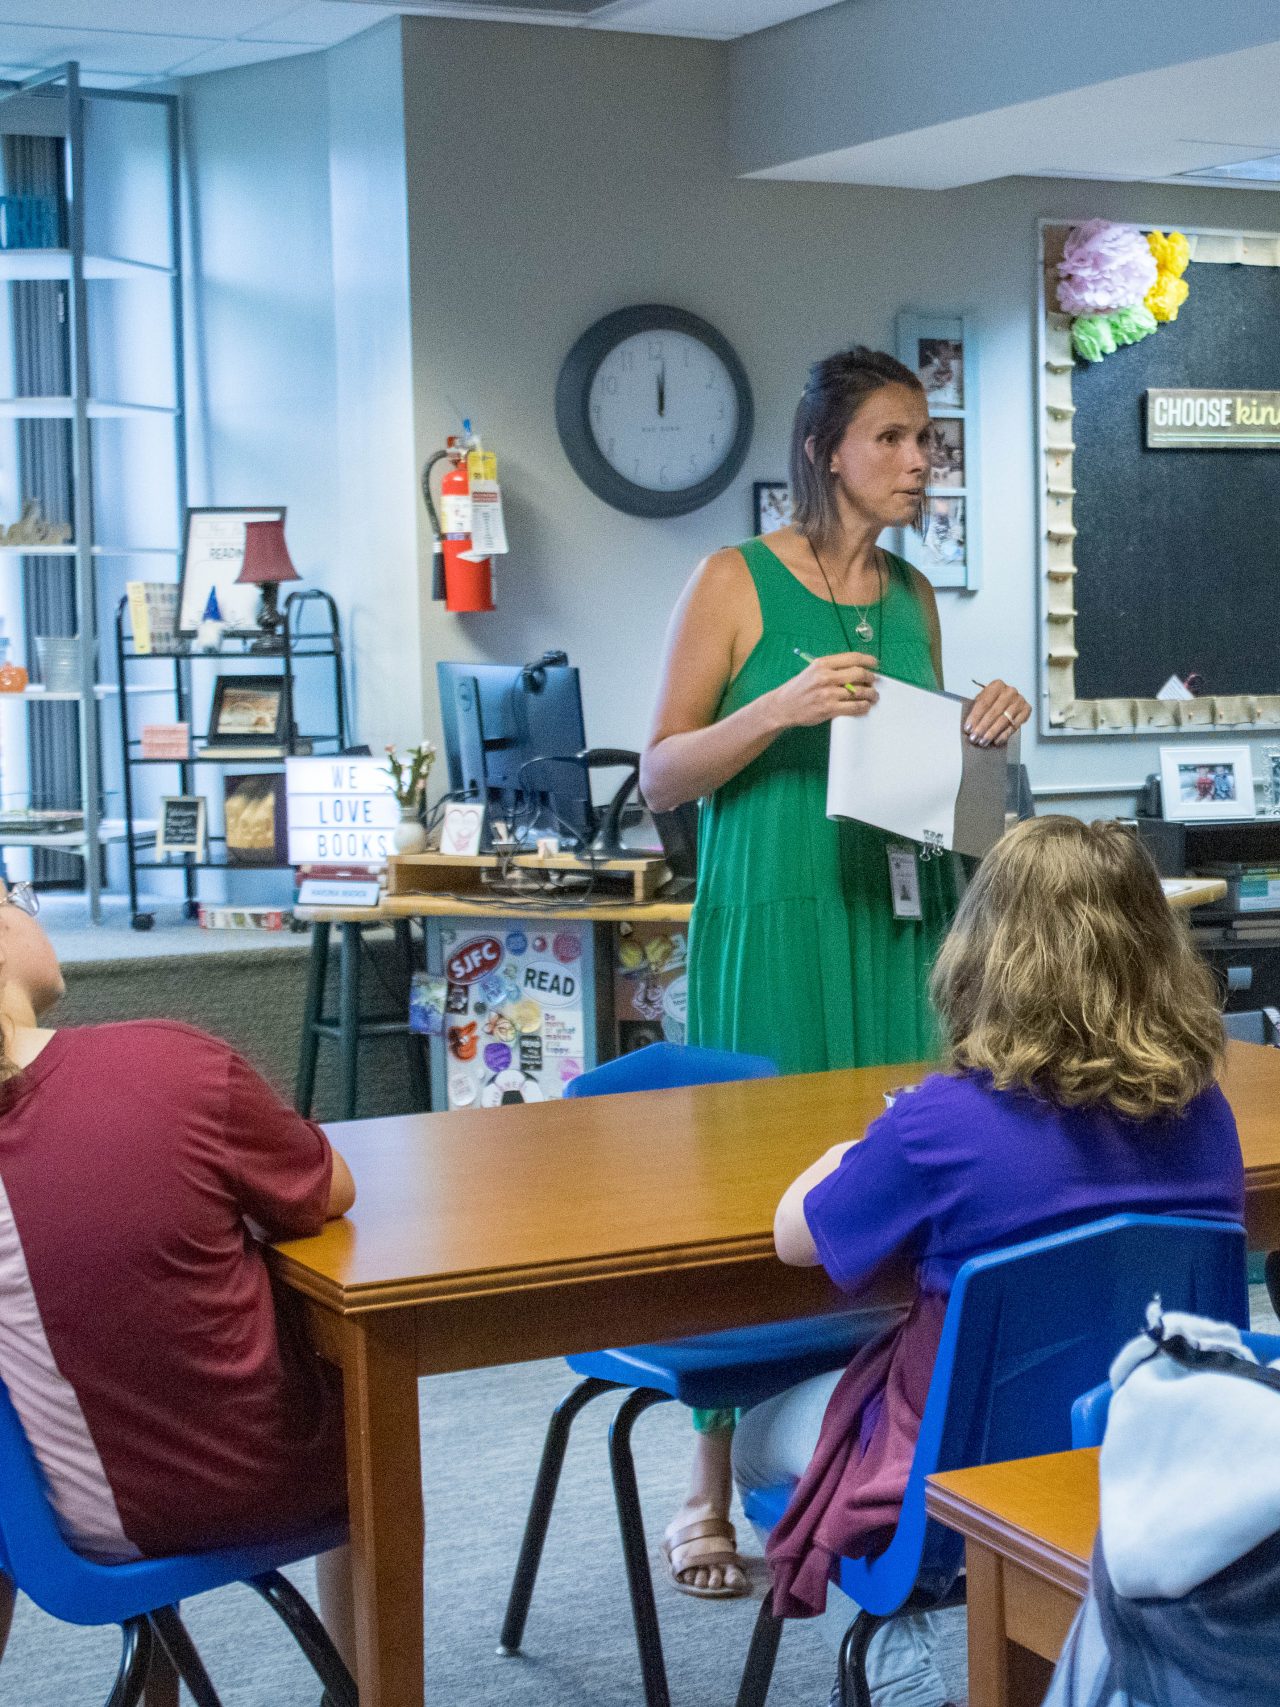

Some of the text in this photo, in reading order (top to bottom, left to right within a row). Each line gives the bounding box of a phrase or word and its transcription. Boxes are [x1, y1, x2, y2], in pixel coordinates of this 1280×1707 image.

[1154, 397, 1232, 426] CHOOSE
[209, 547, 244, 561] READIN
[332, 766, 358, 789] WE
[319, 800, 373, 824] LOVE
[317, 834, 387, 857] BOOKS
[451, 943, 497, 979] SJFC
[524, 968, 575, 997] READ
